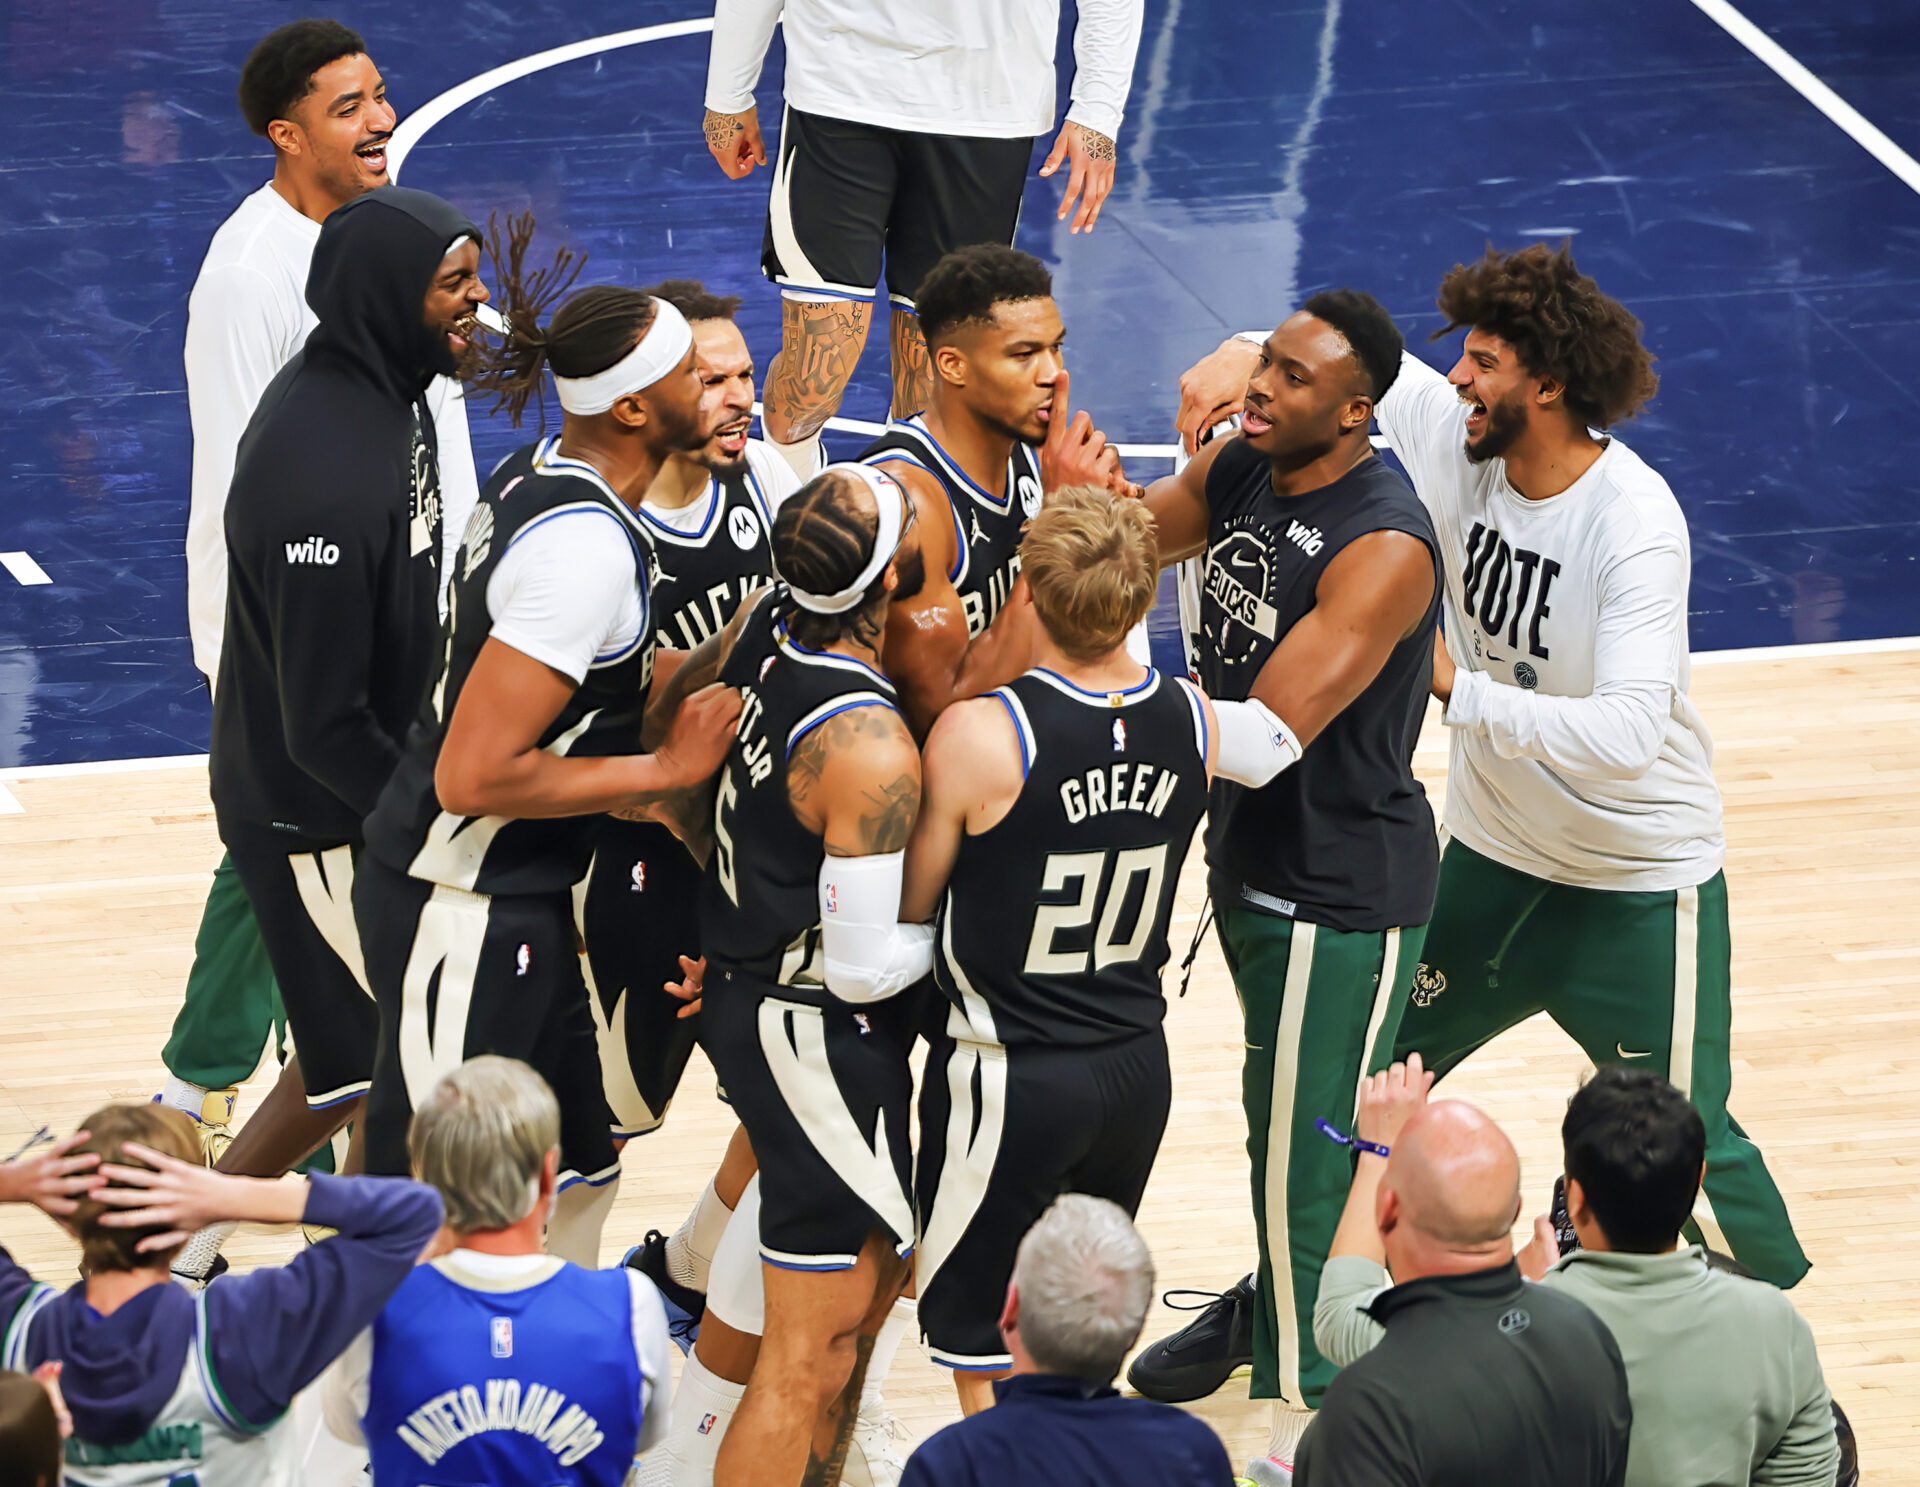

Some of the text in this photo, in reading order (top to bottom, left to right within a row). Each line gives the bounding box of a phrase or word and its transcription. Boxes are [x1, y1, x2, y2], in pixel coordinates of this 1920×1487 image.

[285, 536, 340, 565] wilo
[1286, 520, 1324, 556] wilo
[1205, 564, 1258, 626] BUCKS
[1463, 522, 1561, 661] VOTE
[1060, 763, 1179, 824] GREEN
[1024, 843, 1168, 974] 20
